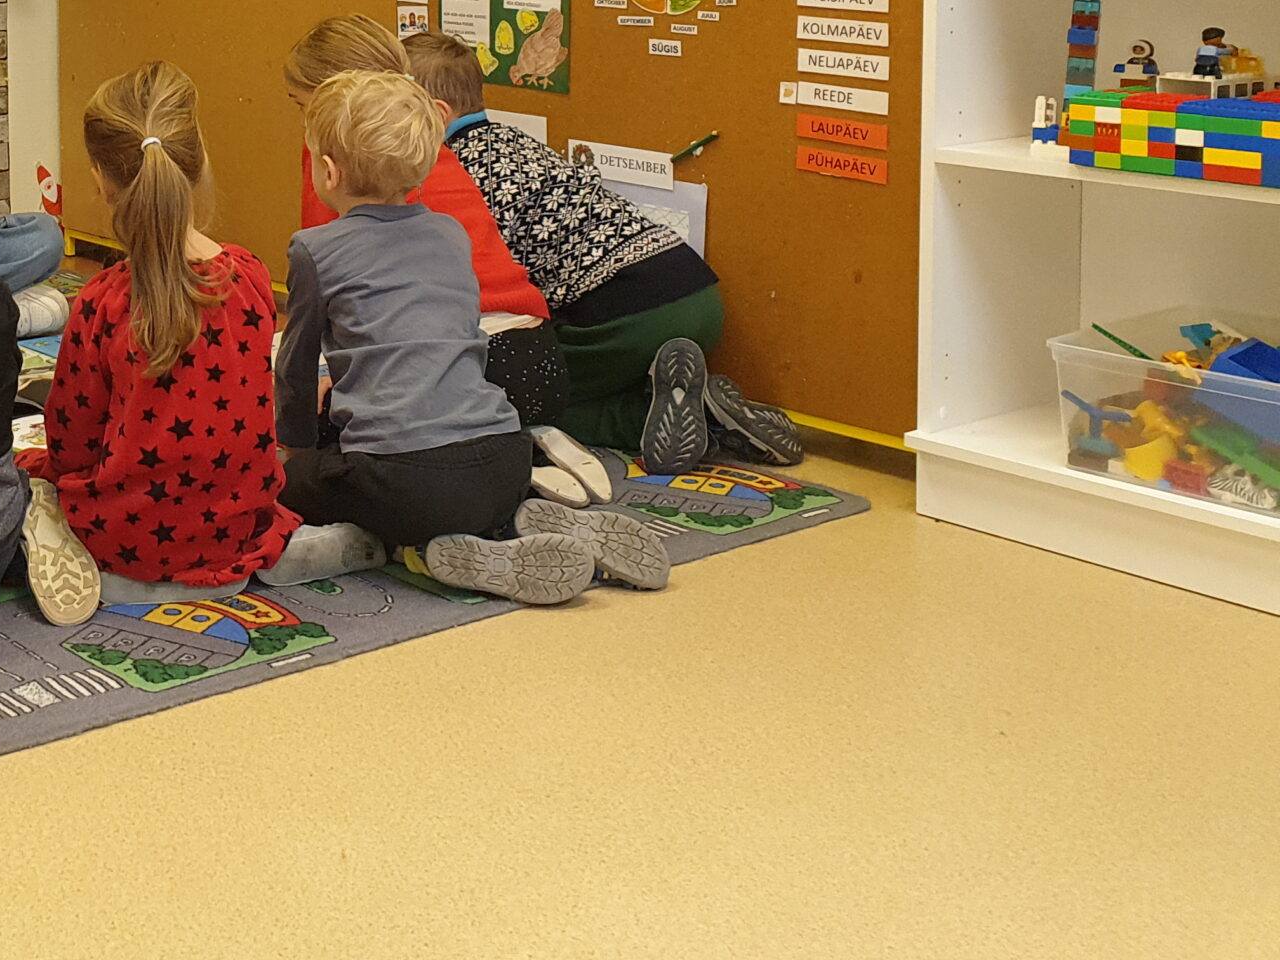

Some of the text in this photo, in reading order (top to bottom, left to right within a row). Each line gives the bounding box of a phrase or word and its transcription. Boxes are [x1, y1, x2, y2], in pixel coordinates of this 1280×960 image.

[802, 21, 882, 41] KOLMAPÄEV
[651, 42, 679, 54] SÜGIS
[808, 54, 879, 73] NELJAPÄEV
[814, 88, 853, 105] REEDE
[811, 120, 869, 141] LAUPÄEV
[600, 154, 667, 175] DETSEMBER
[807, 152, 876, 176] PÜHAPÄEV
